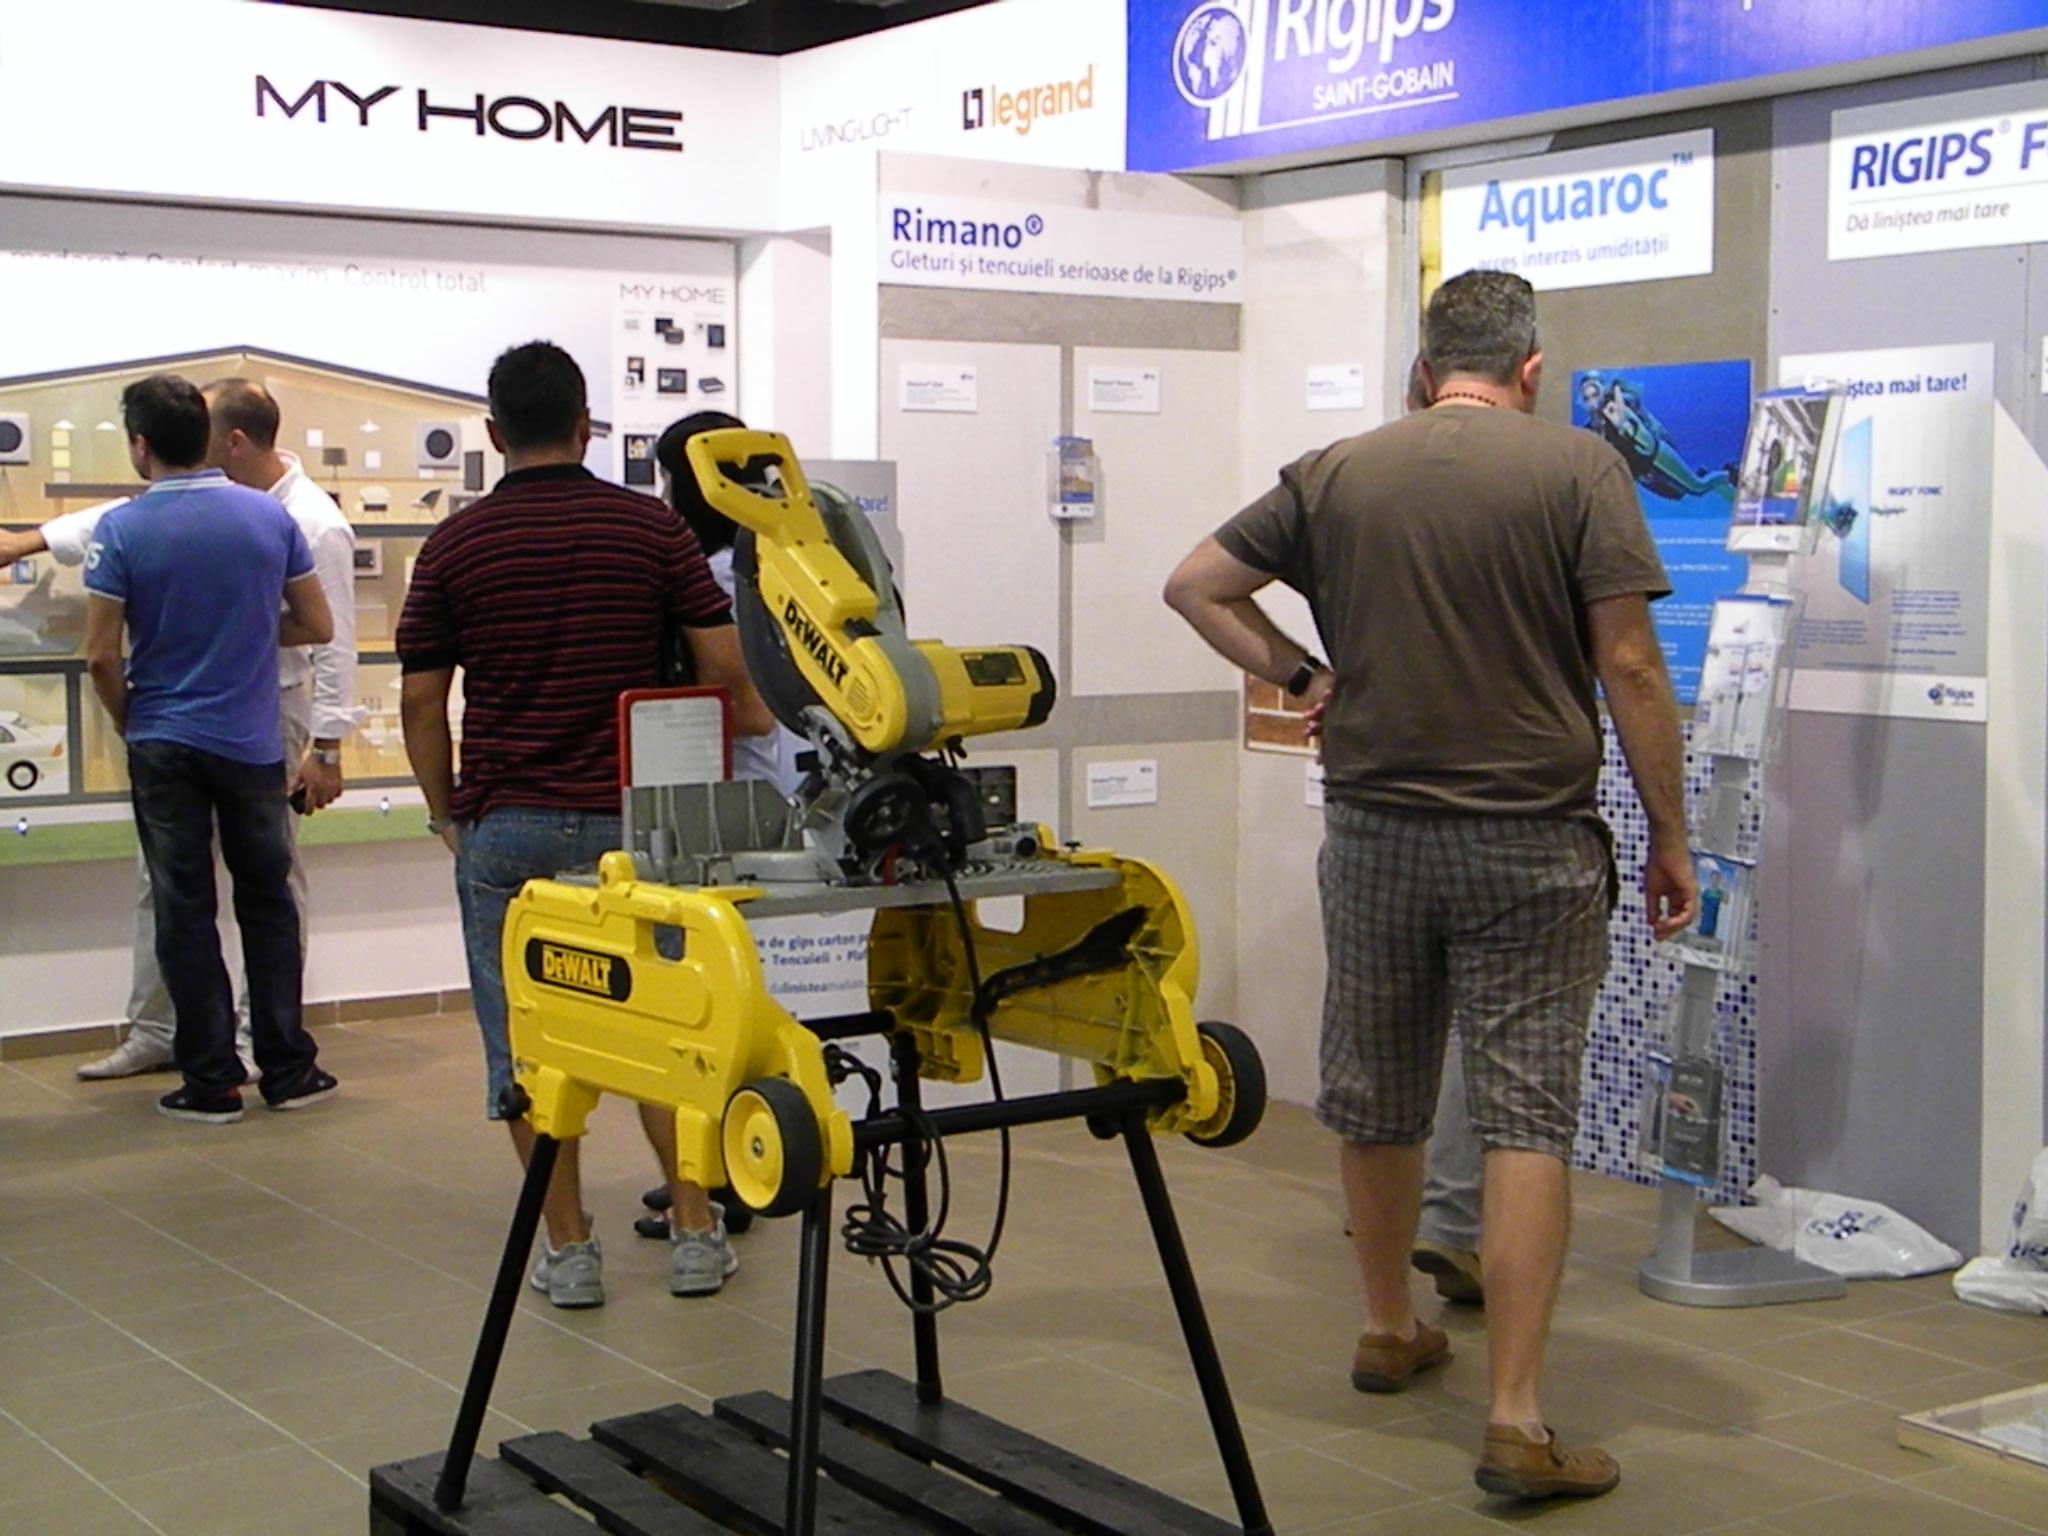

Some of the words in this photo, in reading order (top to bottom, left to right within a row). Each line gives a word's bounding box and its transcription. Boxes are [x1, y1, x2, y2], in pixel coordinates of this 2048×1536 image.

[991, 63, 1093, 136] legrand
[1311, 59, 1456, 112] SAINT-GOBAIN
[255, 74, 402, 127] MY
[417, 88, 684, 152] HOME
[2019, 120, 2048, 170] F
[1937, 204, 1969, 222] mai
[1973, 201, 2010, 219] tare
[890, 249, 954, 273] Gleturi
[978, 256, 1053, 279] tencuieli
[1058, 262, 1130, 284] serioase
[1132, 268, 1155, 284] de
[1157, 269, 1174, 286] la
[1522, 244, 1582, 267] interzis
[620, 284, 654, 301] MY
[660, 286, 726, 305] HOME
[1888, 374, 1921, 395] mai
[1926, 373, 1968, 393] tare!
[769, 937, 785, 949] de
[789, 936, 815, 951] gips
[818, 934, 855, 946] carton
